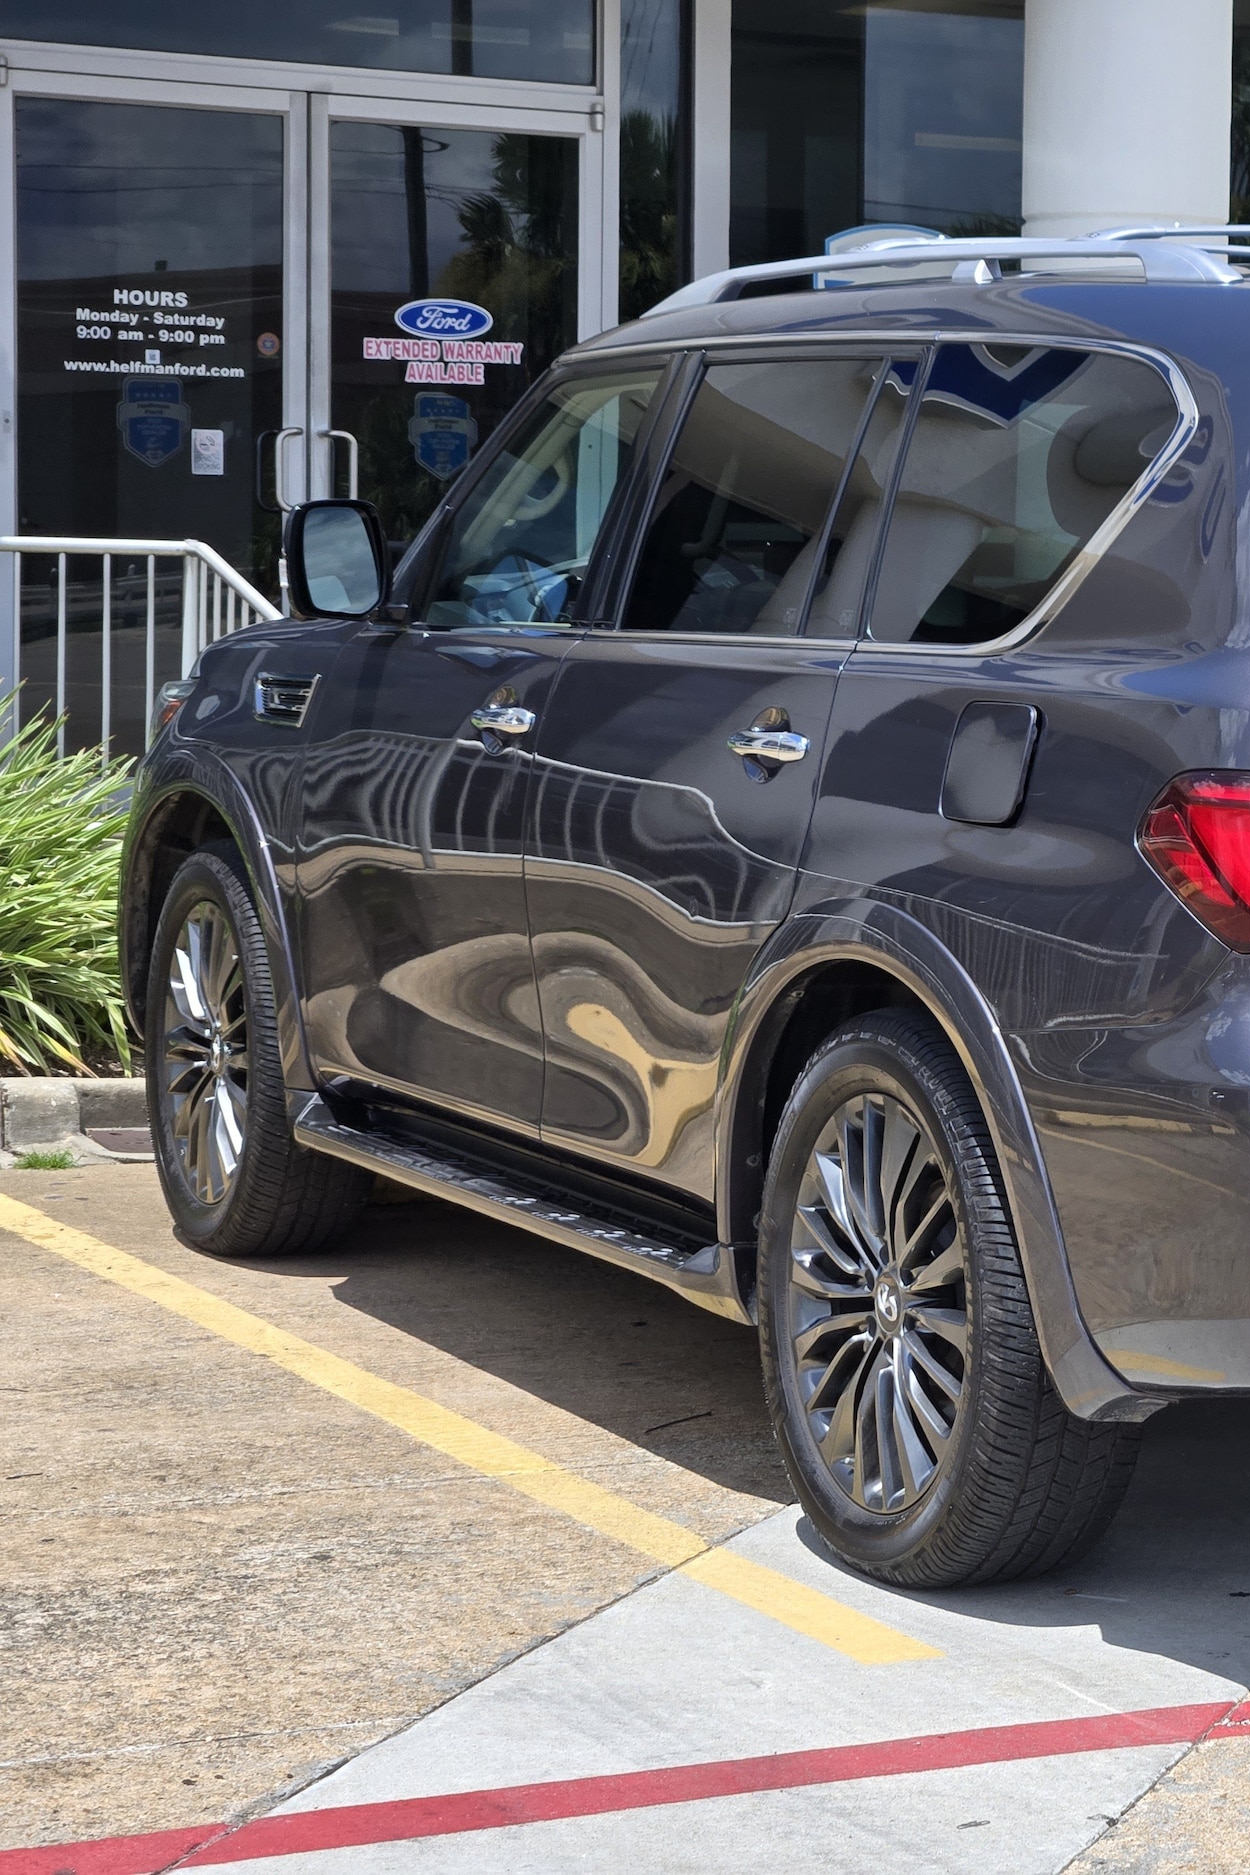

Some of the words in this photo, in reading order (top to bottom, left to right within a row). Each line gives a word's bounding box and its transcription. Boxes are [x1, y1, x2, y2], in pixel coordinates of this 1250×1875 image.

[113, 288, 188, 308] HOURS
[76, 308, 139, 325] Monday
[153, 311, 225, 330] Saturday
[416, 306, 471, 331] Ford
[76, 325, 112, 340] 9:00
[118, 329, 144, 341] am
[158, 329, 195, 344] 9:00
[200, 333, 226, 347] pm
[364, 339, 440, 360] EXTENDED
[443, 343, 523, 364] WARRANTY
[63, 360, 245, 378] www.helfmanford.com
[407, 363, 483, 383] AVAILABLE
